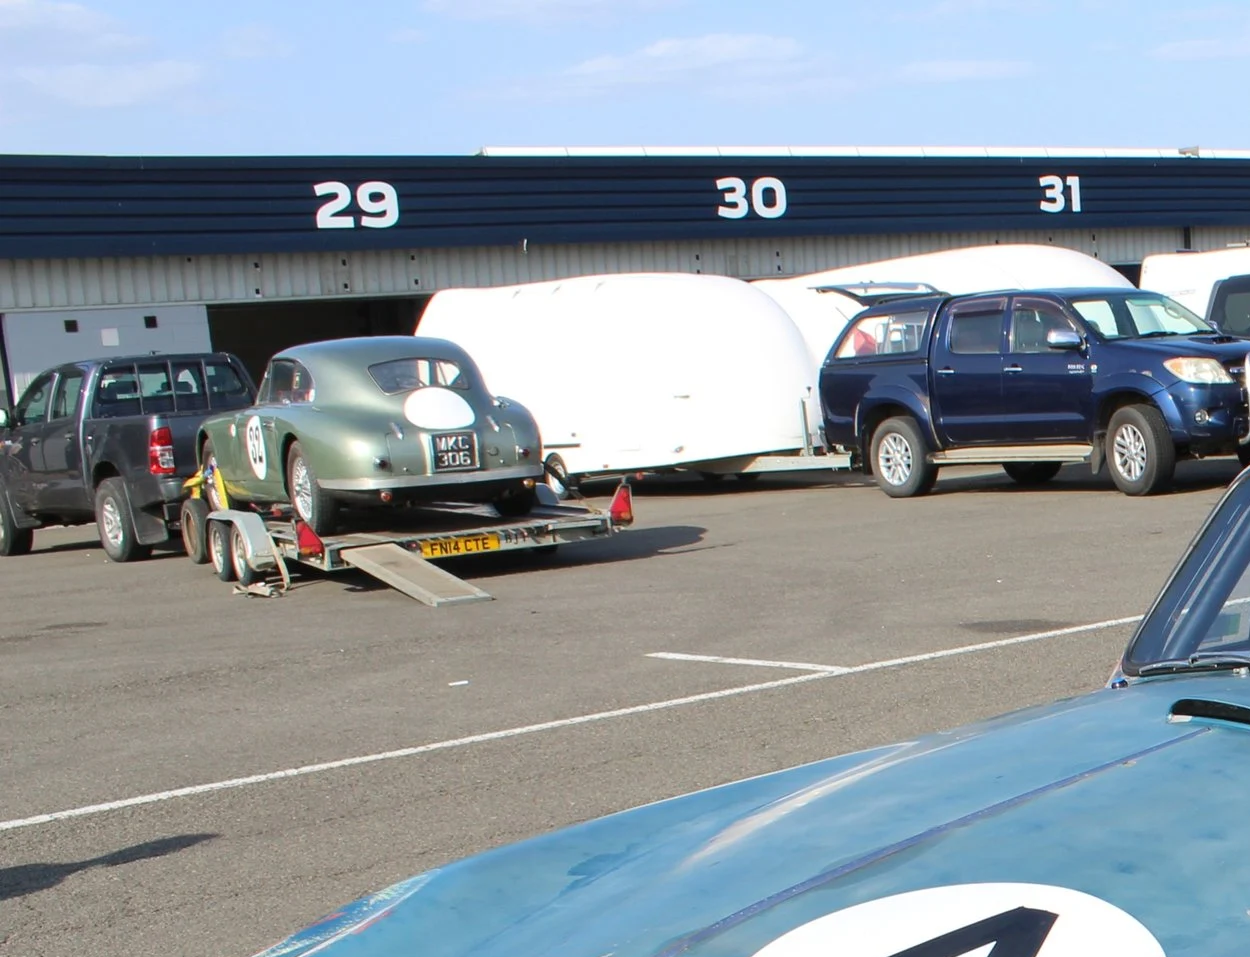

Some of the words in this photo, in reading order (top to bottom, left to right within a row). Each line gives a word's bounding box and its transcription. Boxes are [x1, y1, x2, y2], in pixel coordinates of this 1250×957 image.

[313, 181, 399, 228] 29
[716, 176, 787, 218] 30
[1039, 175, 1082, 212] 31
[248, 424, 265, 465] 32
[436, 433, 469, 451] MKC
[438, 450, 471, 468] 306
[429, 541, 461, 556] FN14
[464, 537, 491, 553] CTE
